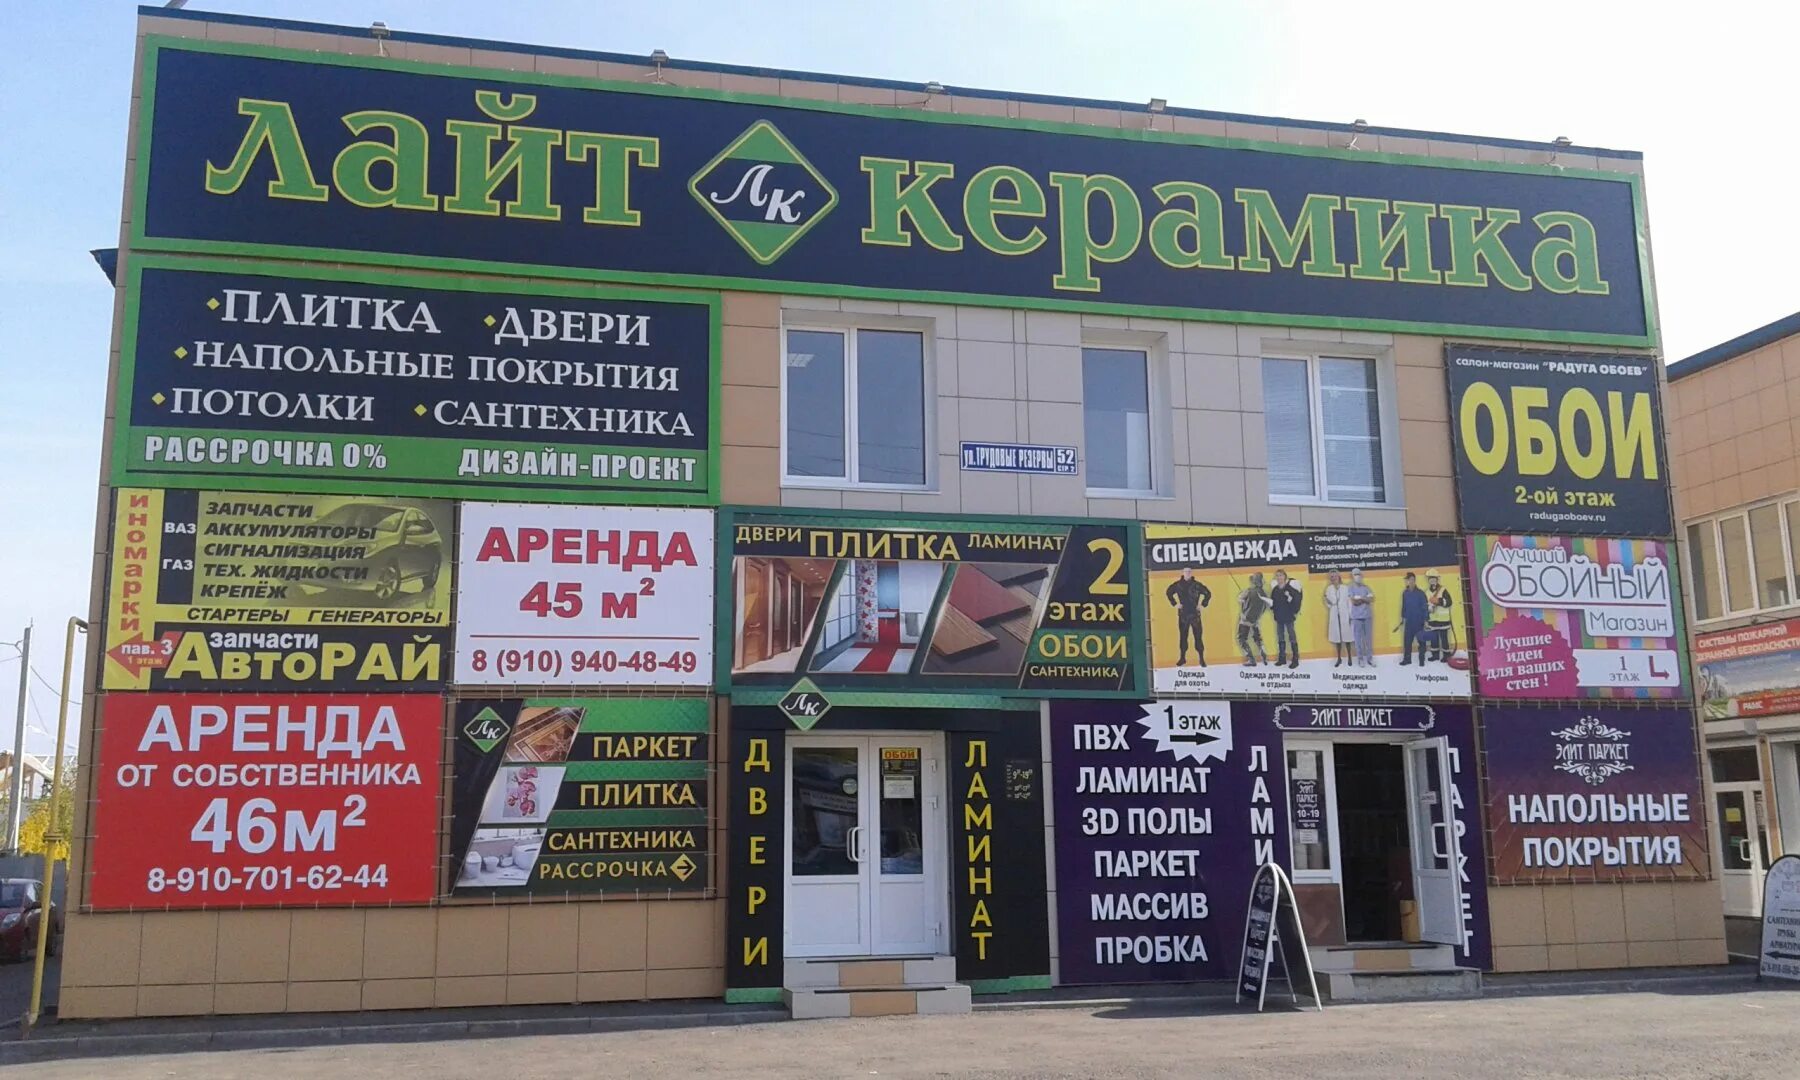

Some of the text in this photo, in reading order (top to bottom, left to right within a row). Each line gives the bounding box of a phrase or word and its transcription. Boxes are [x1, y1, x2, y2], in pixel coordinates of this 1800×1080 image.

[205, 89, 1609, 296] Лайт керамика
[221, 289, 650, 346] ПЛИТКА ДВЕРИ
[193, 341, 679, 391] НАПОЛЬНЫЕ ПОКРЫТИЯ
[170, 387, 694, 437] ПОТОЛКИ САНТЕХНИКА
[1460, 381, 1658, 480] ОБОИ
[144, 436, 697, 482] РАССРОЧКА 0% ДИЗАЙН-ПРОЕКТ
[1019, 449, 1053, 468] РЕЗЕРВЫ
[1057, 450, 1074, 464] 52
[1515, 485, 1616, 507] 2-ой этаж
[206, 502, 313, 518] ЗАПЧАСТИ
[1530, 512, 1606, 522] radugaoboev.ru
[165, 522, 196, 534] ВАЗ
[204, 523, 376, 539] АККУМУЛЯТОРЫ
[204, 544, 365, 560] СИГНАЛИЗАЦИЯ
[476, 526, 698, 570] АРЕНДА
[736, 526, 1065, 560] ДВЕРИ ПЛИТКА ЛАМИНАТ
[1152, 540, 1297, 564] СПЕЦОДЕЖДА
[1492, 543, 1566, 564] Лучший
[121, 494, 148, 631] иномарки
[162, 559, 193, 570] ГАЗ
[204, 564, 368, 582] ТЕХ. ЖИДКОСТИ
[1087, 538, 1128, 595] 2
[201, 581, 288, 599] КРЕПЁЖ
[1486, 558, 1666, 600] ОБОЙНЫЙ
[520, 581, 583, 619] 45
[187, 608, 442, 624] СТАРТЕРЫ ГЕНЕРАТОРЫ
[1049, 602, 1124, 622] этаж
[1590, 612, 1667, 631] Магазин
[121, 640, 173, 656] пав. 3
[209, 632, 318, 649] запчасти
[1038, 634, 1126, 659] ОБОИ
[1494, 633, 1552, 650] Лучшие
[136, 658, 162, 666] этаж
[472, 649, 697, 678] 8 (910) 940-48-49
[1507, 650, 1543, 663] идеи
[1619, 657, 1627, 670] 1
[1030, 665, 1119, 678] САНТЕХНИКА
[1178, 670, 1205, 678] Одежда
[1240, 671, 1266, 680] Одежда
[1282, 672, 1310, 680] рыбалки
[1332, 673, 1376, 681] Медицинская
[1416, 674, 1448, 682] Униформа
[1486, 660, 1565, 681] для ваших
[1609, 673, 1640, 682] ЭТАЖ
[1164, 705, 1220, 730] 1 ЭТАЖ
[1311, 708, 1392, 726] ЭЛИТ ПАРКЕТ
[138, 705, 406, 759] АРЕНДА
[1074, 724, 1130, 750] ПВХ
[593, 736, 696, 758] ПАРКЕТ
[1556, 744, 1629, 760] ЭЛИТ ПАРКЕТ
[117, 763, 422, 787] ОТ СОБСТВЕННИКА
[1076, 767, 1211, 793] ЛАМИНАТ
[580, 784, 696, 806] ПЛИТКА
[1508, 794, 1690, 824] НАПОЛЬНЫЕ
[1082, 808, 1212, 835] 3D ПОЛЫ
[549, 831, 696, 850] САНТЕХНИКА
[964, 740, 993, 960] ЛАМИНАТ
[1523, 836, 1682, 867] ПОКРЫТИЯ
[744, 739, 770, 965] ДВЕРИ
[540, 861, 667, 879] РАССРОЧКА
[1094, 850, 1200, 877] ПАРКЕТ
[148, 864, 388, 892] 8-910-701-62-44
[1091, 893, 1208, 921] МАССИВ
[1096, 936, 1208, 964] ПРОБКА
